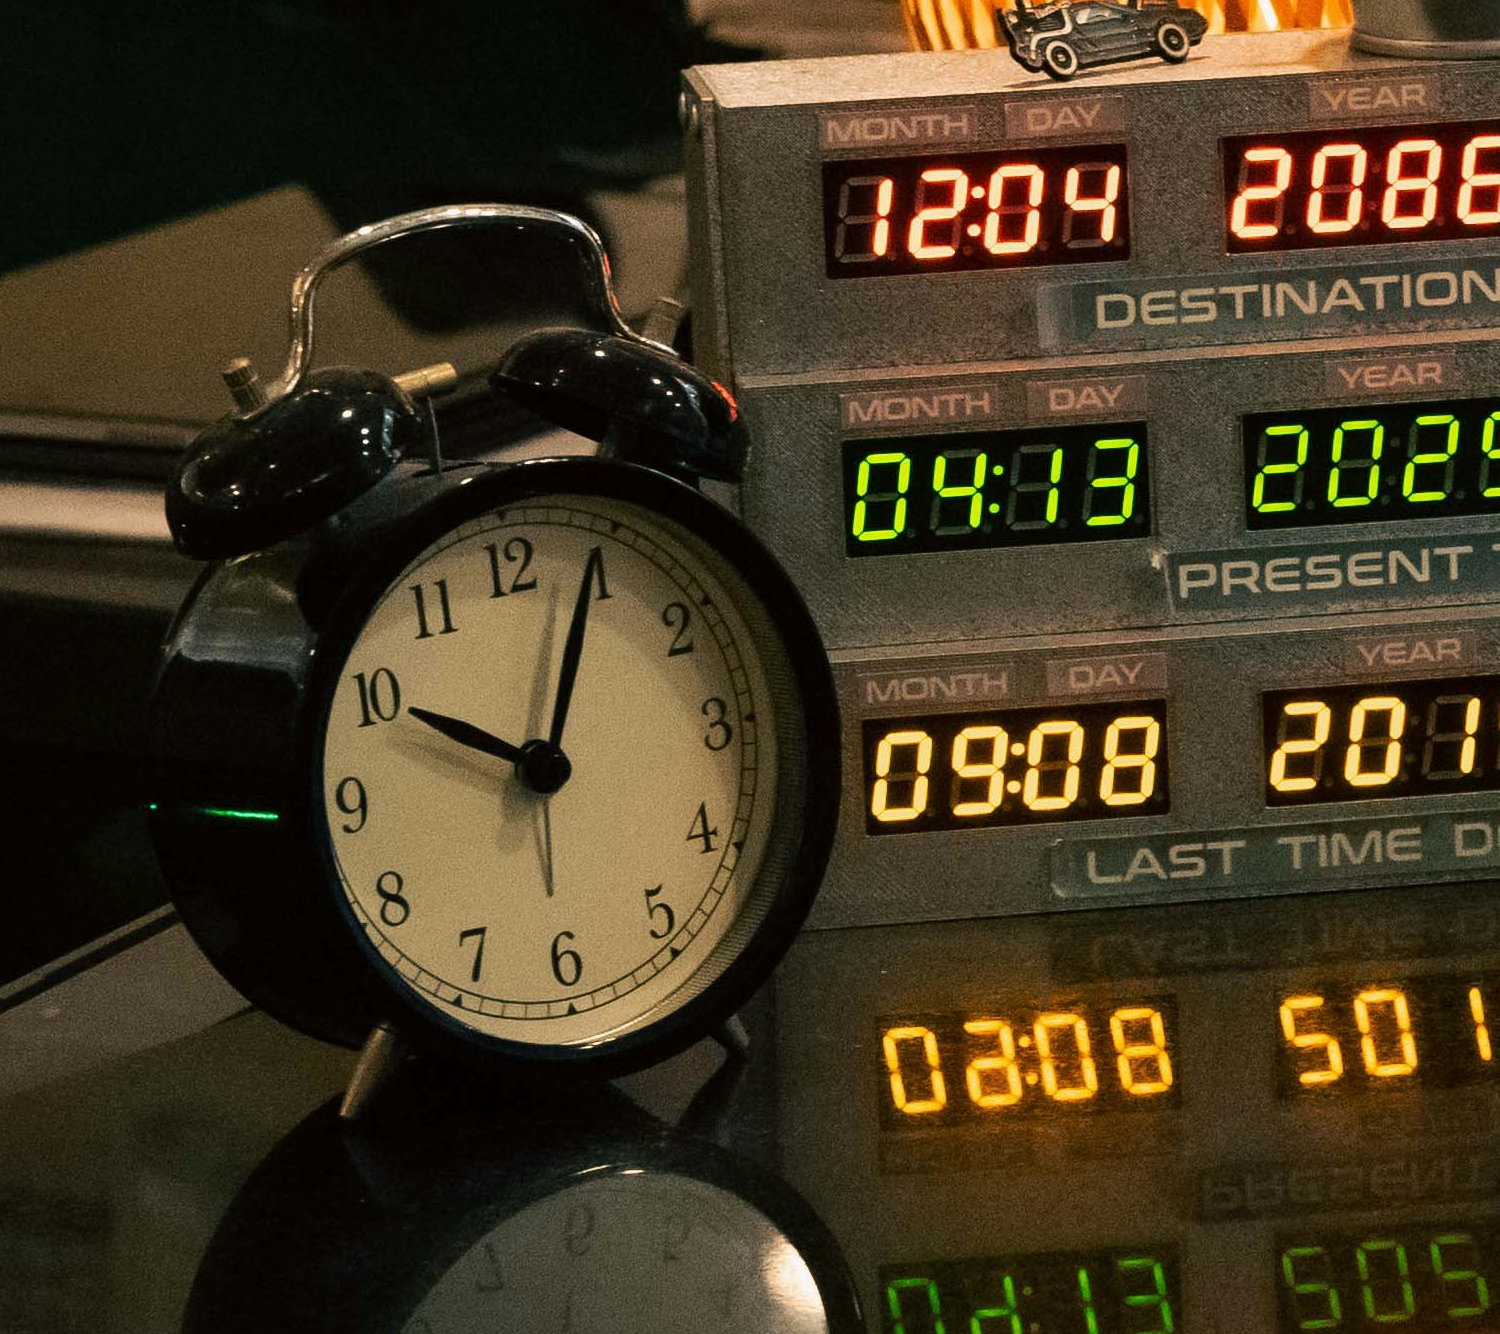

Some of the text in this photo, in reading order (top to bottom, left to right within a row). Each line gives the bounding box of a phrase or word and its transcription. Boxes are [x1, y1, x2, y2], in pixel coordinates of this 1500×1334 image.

[826, 114, 970, 143] MONTH
[1026, 104, 1103, 132] DAY
[1319, 83, 1427, 111] YEAR
[872, 164, 1121, 262] 12:04
[848, 392, 991, 423] MONTH
[1048, 384, 1125, 412] DAY
[1337, 360, 1443, 388] YEAR
[851, 437, 1141, 542] 04:13
[483, 536, 538, 599] 12
[1177, 544, 1474, 599] PRESENT
[409, 578, 459, 640] 11
[661, 601, 694, 658] 2
[352, 667, 401, 728] 10
[866, 672, 1009, 704] MONTH
[1067, 663, 1145, 691] DAY
[1357, 639, 1461, 667] YEAR
[701, 696, 733, 752] 3
[871, 715, 1161, 823] 09:08
[335, 775, 368, 834] 9
[685, 801, 719, 855] 4
[1087, 839, 1247, 885] LAST
[1277, 827, 1423, 871] TIME
[375, 870, 411, 927] 8
[643, 883, 676, 940] 5
[458, 926, 488, 983] 7
[550, 931, 583, 987] 6
